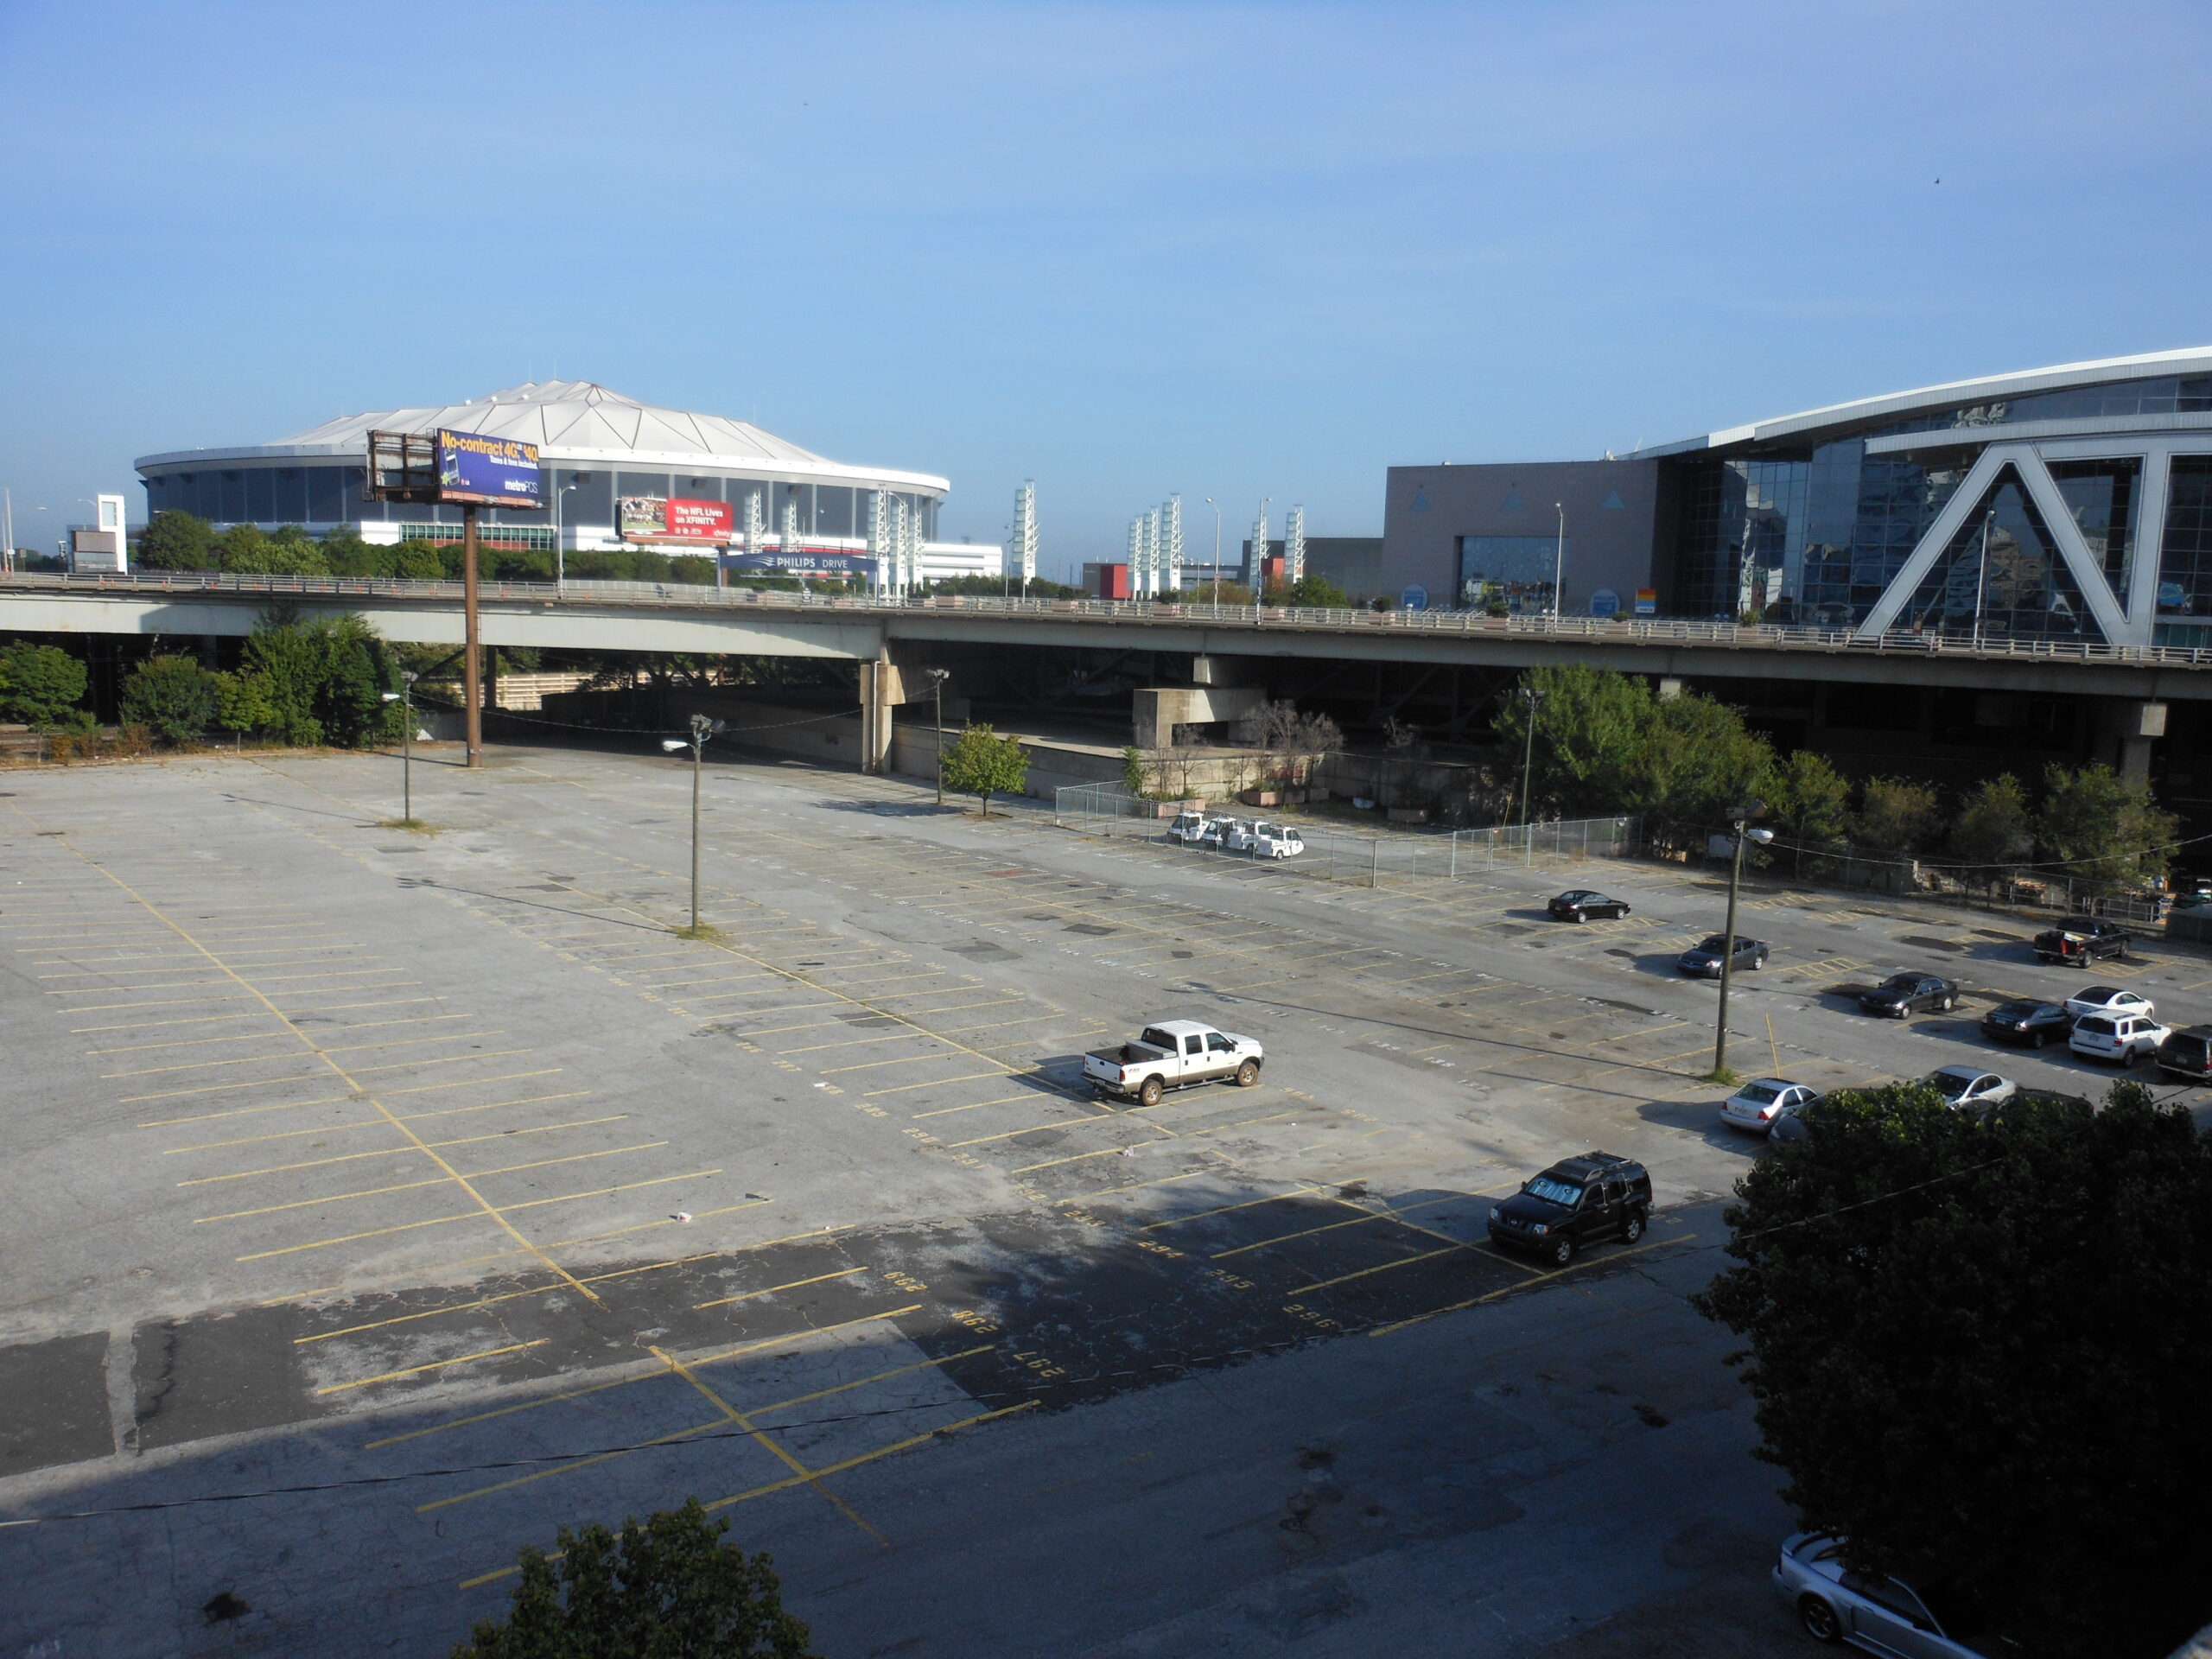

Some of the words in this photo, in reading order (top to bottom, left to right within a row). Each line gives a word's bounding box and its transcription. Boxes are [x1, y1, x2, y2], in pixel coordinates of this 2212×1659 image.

[442, 430, 503, 455] No-contract
[505, 480, 538, 494] metroPCS
[675, 506, 687, 516] The
[690, 507, 704, 517] NFL
[705, 508, 724, 518] Lives
[777, 556, 816, 569] PHILIPS
[823, 559, 849, 569] DRIVE
[1138, 1240, 1184, 1259] 294
[884, 1271, 928, 1293] 299
[951, 1310, 999, 1334] 298
[1013, 1351, 1065, 1378] 297
